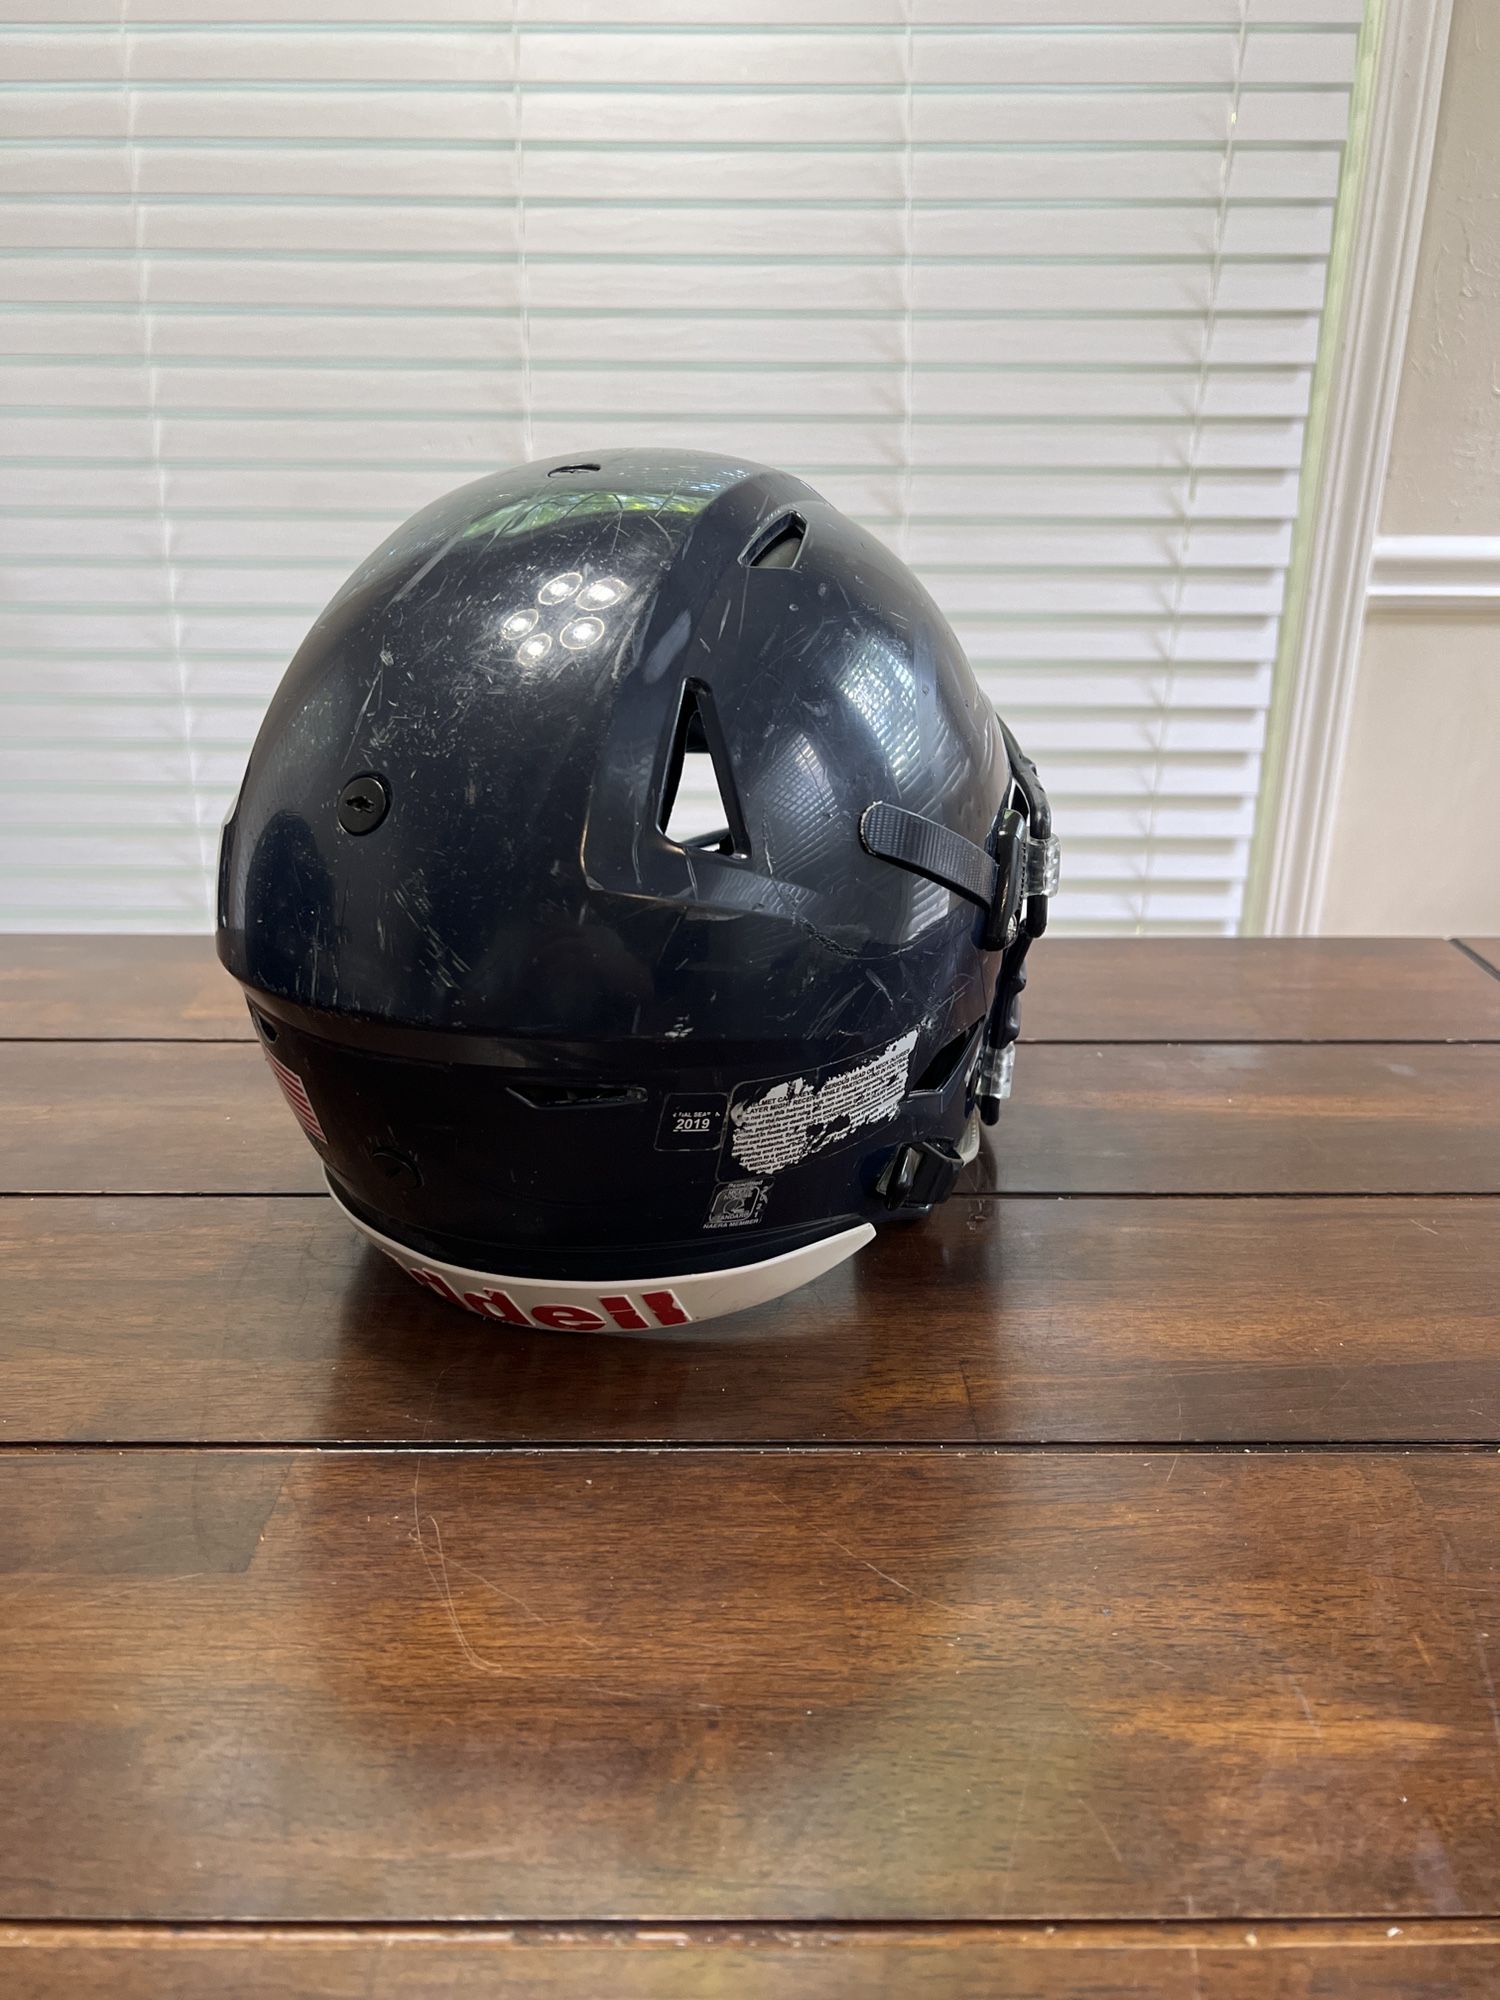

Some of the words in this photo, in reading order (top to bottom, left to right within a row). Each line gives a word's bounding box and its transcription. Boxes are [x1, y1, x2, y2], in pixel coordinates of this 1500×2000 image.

[850, 1070, 865, 1080] HEAD
[746, 1106, 768, 1114] LAYER
[822, 1086, 840, 1097] WHILE
[786, 1104, 804, 1113] helmet
[675, 1118, 710, 1130] 2019
